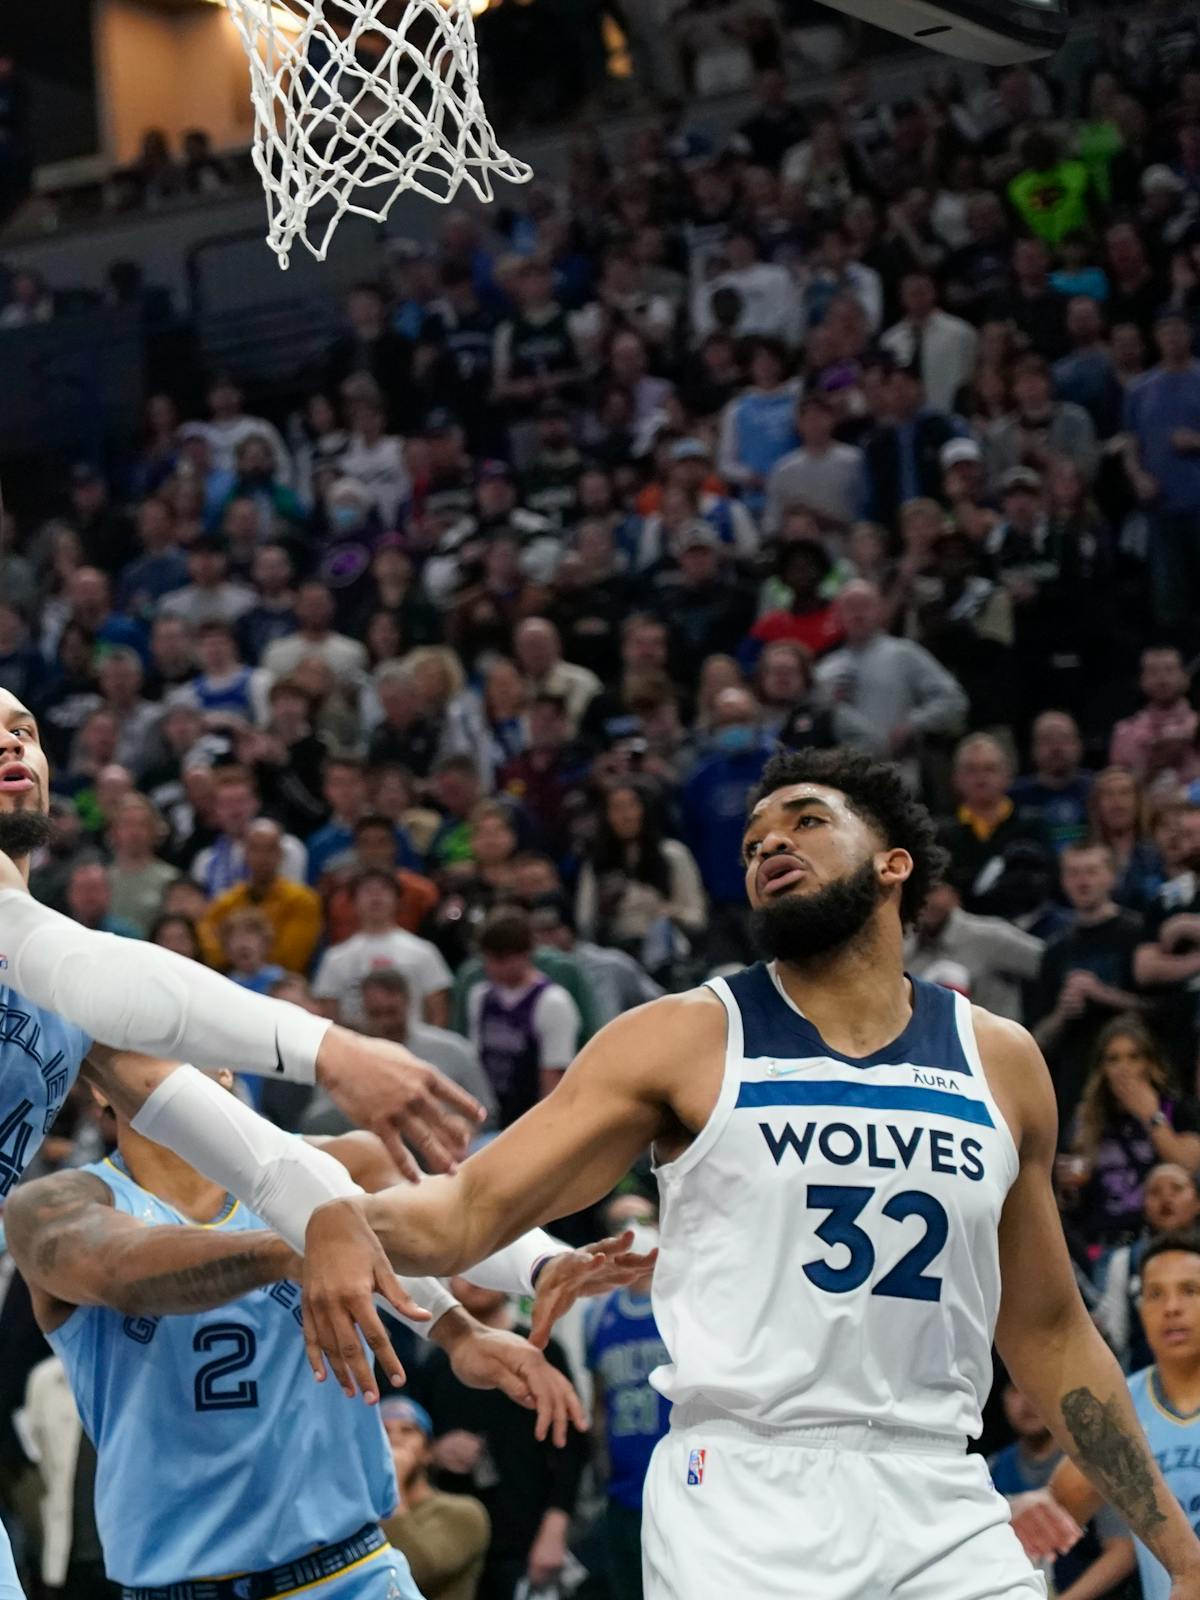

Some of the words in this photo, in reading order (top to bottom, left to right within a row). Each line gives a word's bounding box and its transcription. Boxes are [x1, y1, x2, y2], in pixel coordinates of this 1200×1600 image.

[757, 1121, 985, 1182] WOLVES
[801, 1184, 949, 1303] 32
[192, 1322, 259, 1413] 2
